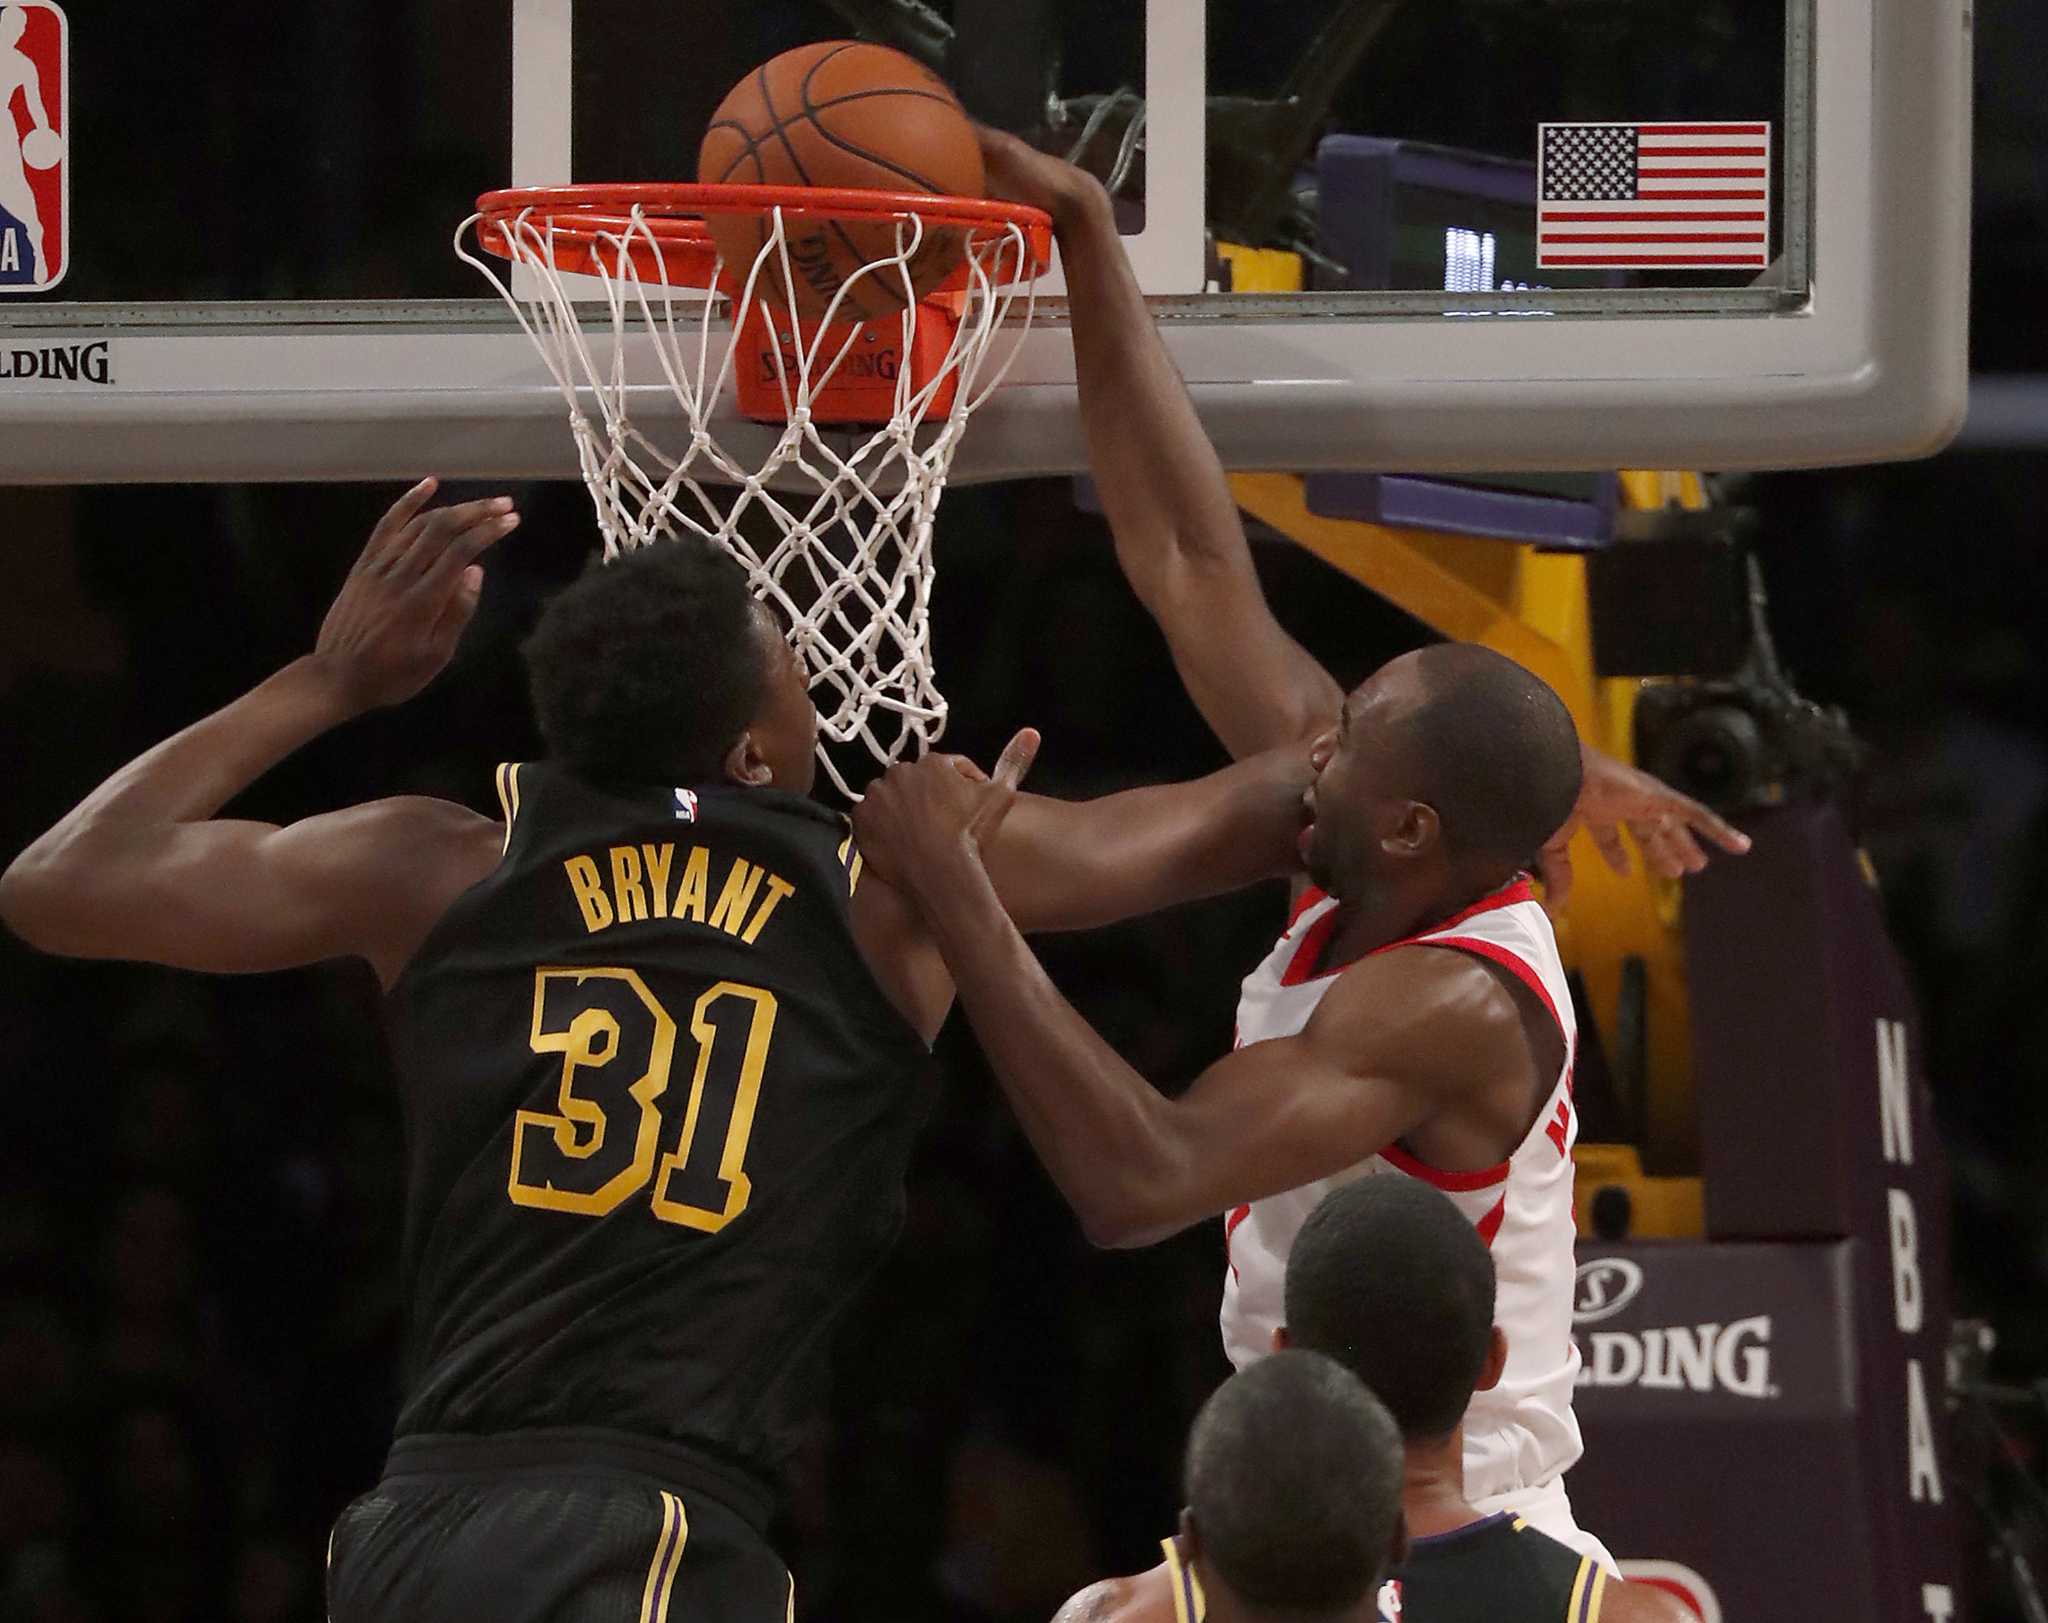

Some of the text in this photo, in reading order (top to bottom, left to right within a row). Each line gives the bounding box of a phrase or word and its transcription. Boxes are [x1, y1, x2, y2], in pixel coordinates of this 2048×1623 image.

[563, 842, 796, 945] BRYANT
[508, 966, 778, 1234] 31
[1875, 1017, 1944, 1504] NBA
